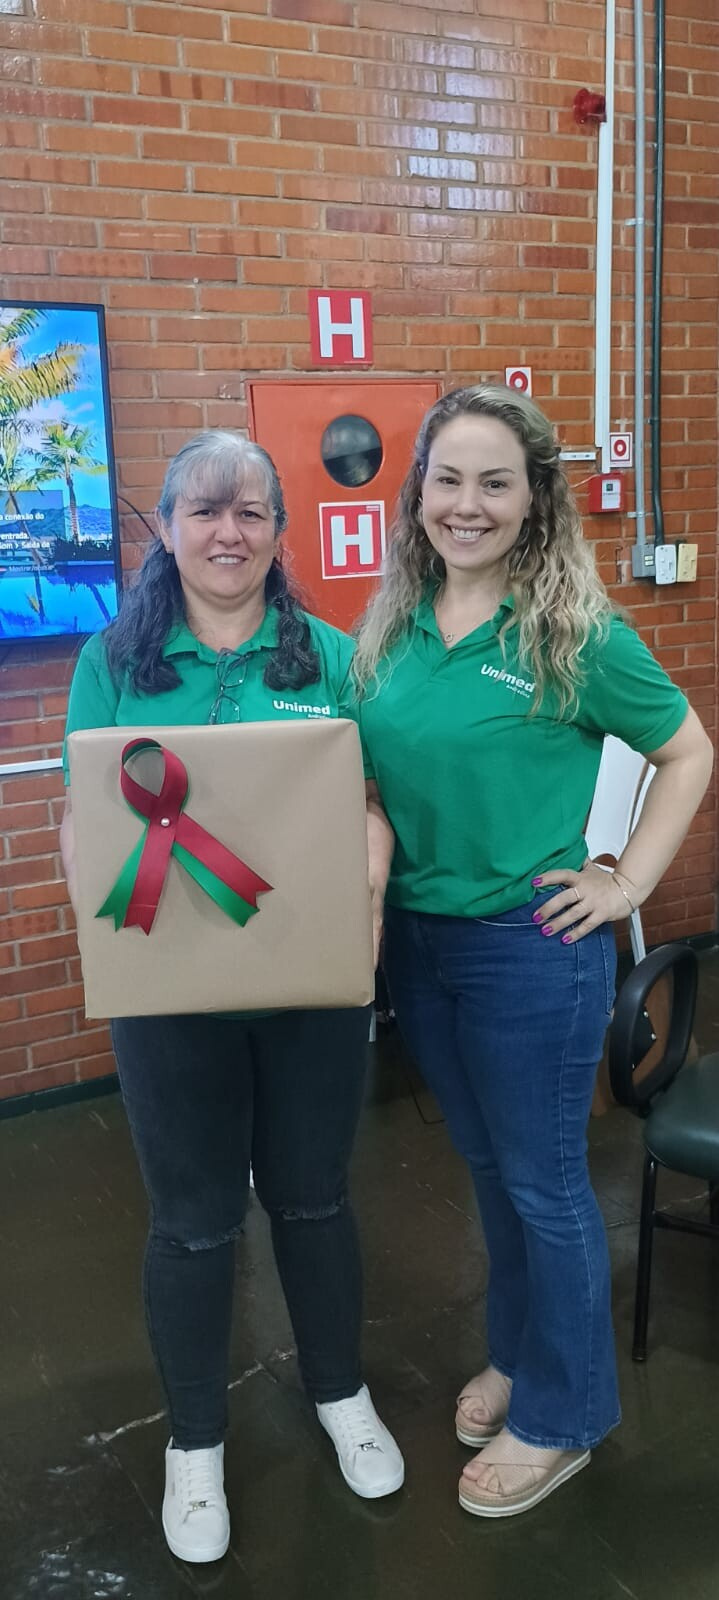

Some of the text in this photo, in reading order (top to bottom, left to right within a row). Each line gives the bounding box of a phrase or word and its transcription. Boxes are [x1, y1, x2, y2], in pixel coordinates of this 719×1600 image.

[317, 296, 365, 358] H
[35, 512, 45, 520] do
[1, 532, 30, 540] entrada.
[331, 514, 374, 566] H
[273, 700, 331, 715] Unimed
